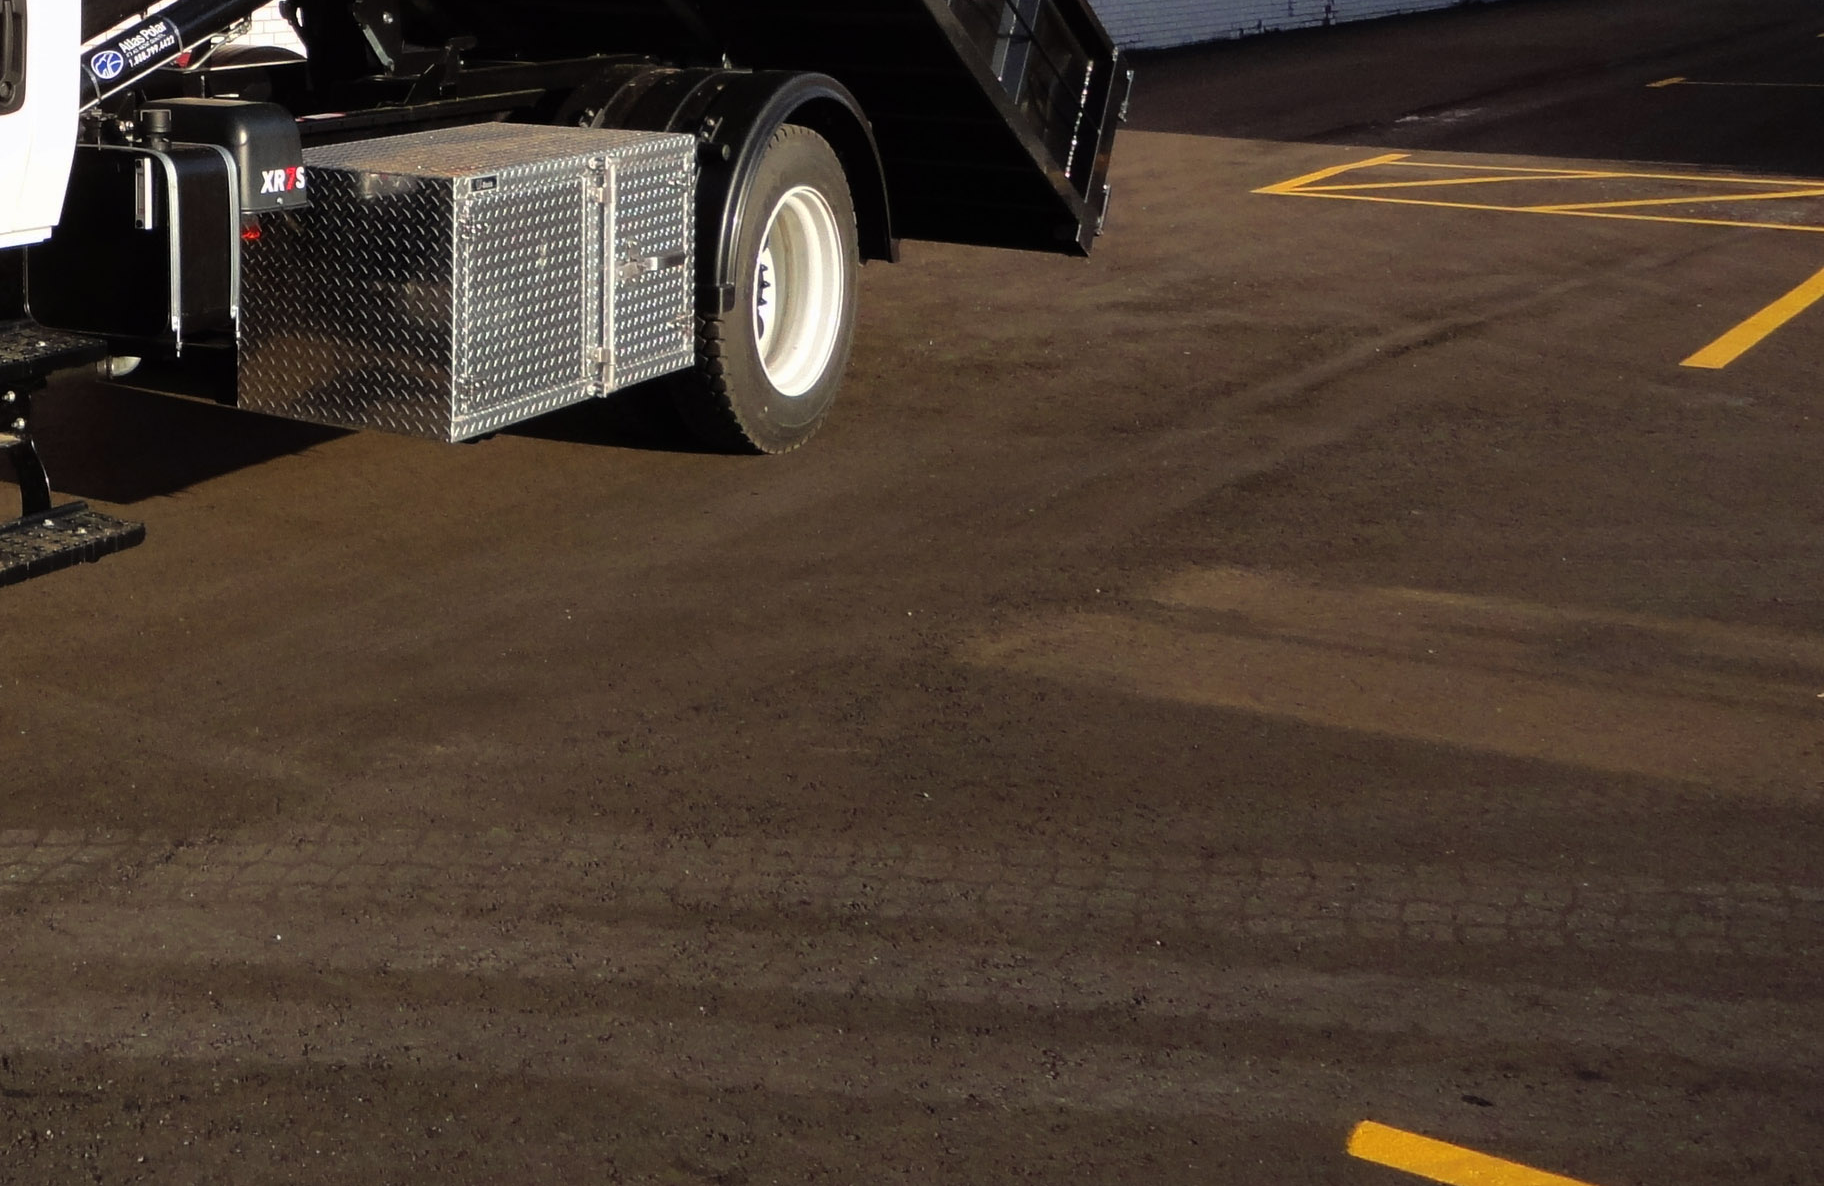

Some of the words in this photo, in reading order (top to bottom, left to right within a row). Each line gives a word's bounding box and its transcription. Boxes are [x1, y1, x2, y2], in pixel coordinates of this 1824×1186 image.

[118, 33, 146, 54] Atlas
[140, 21, 167, 41] Polar
[260, 166, 306, 194] XR7S
